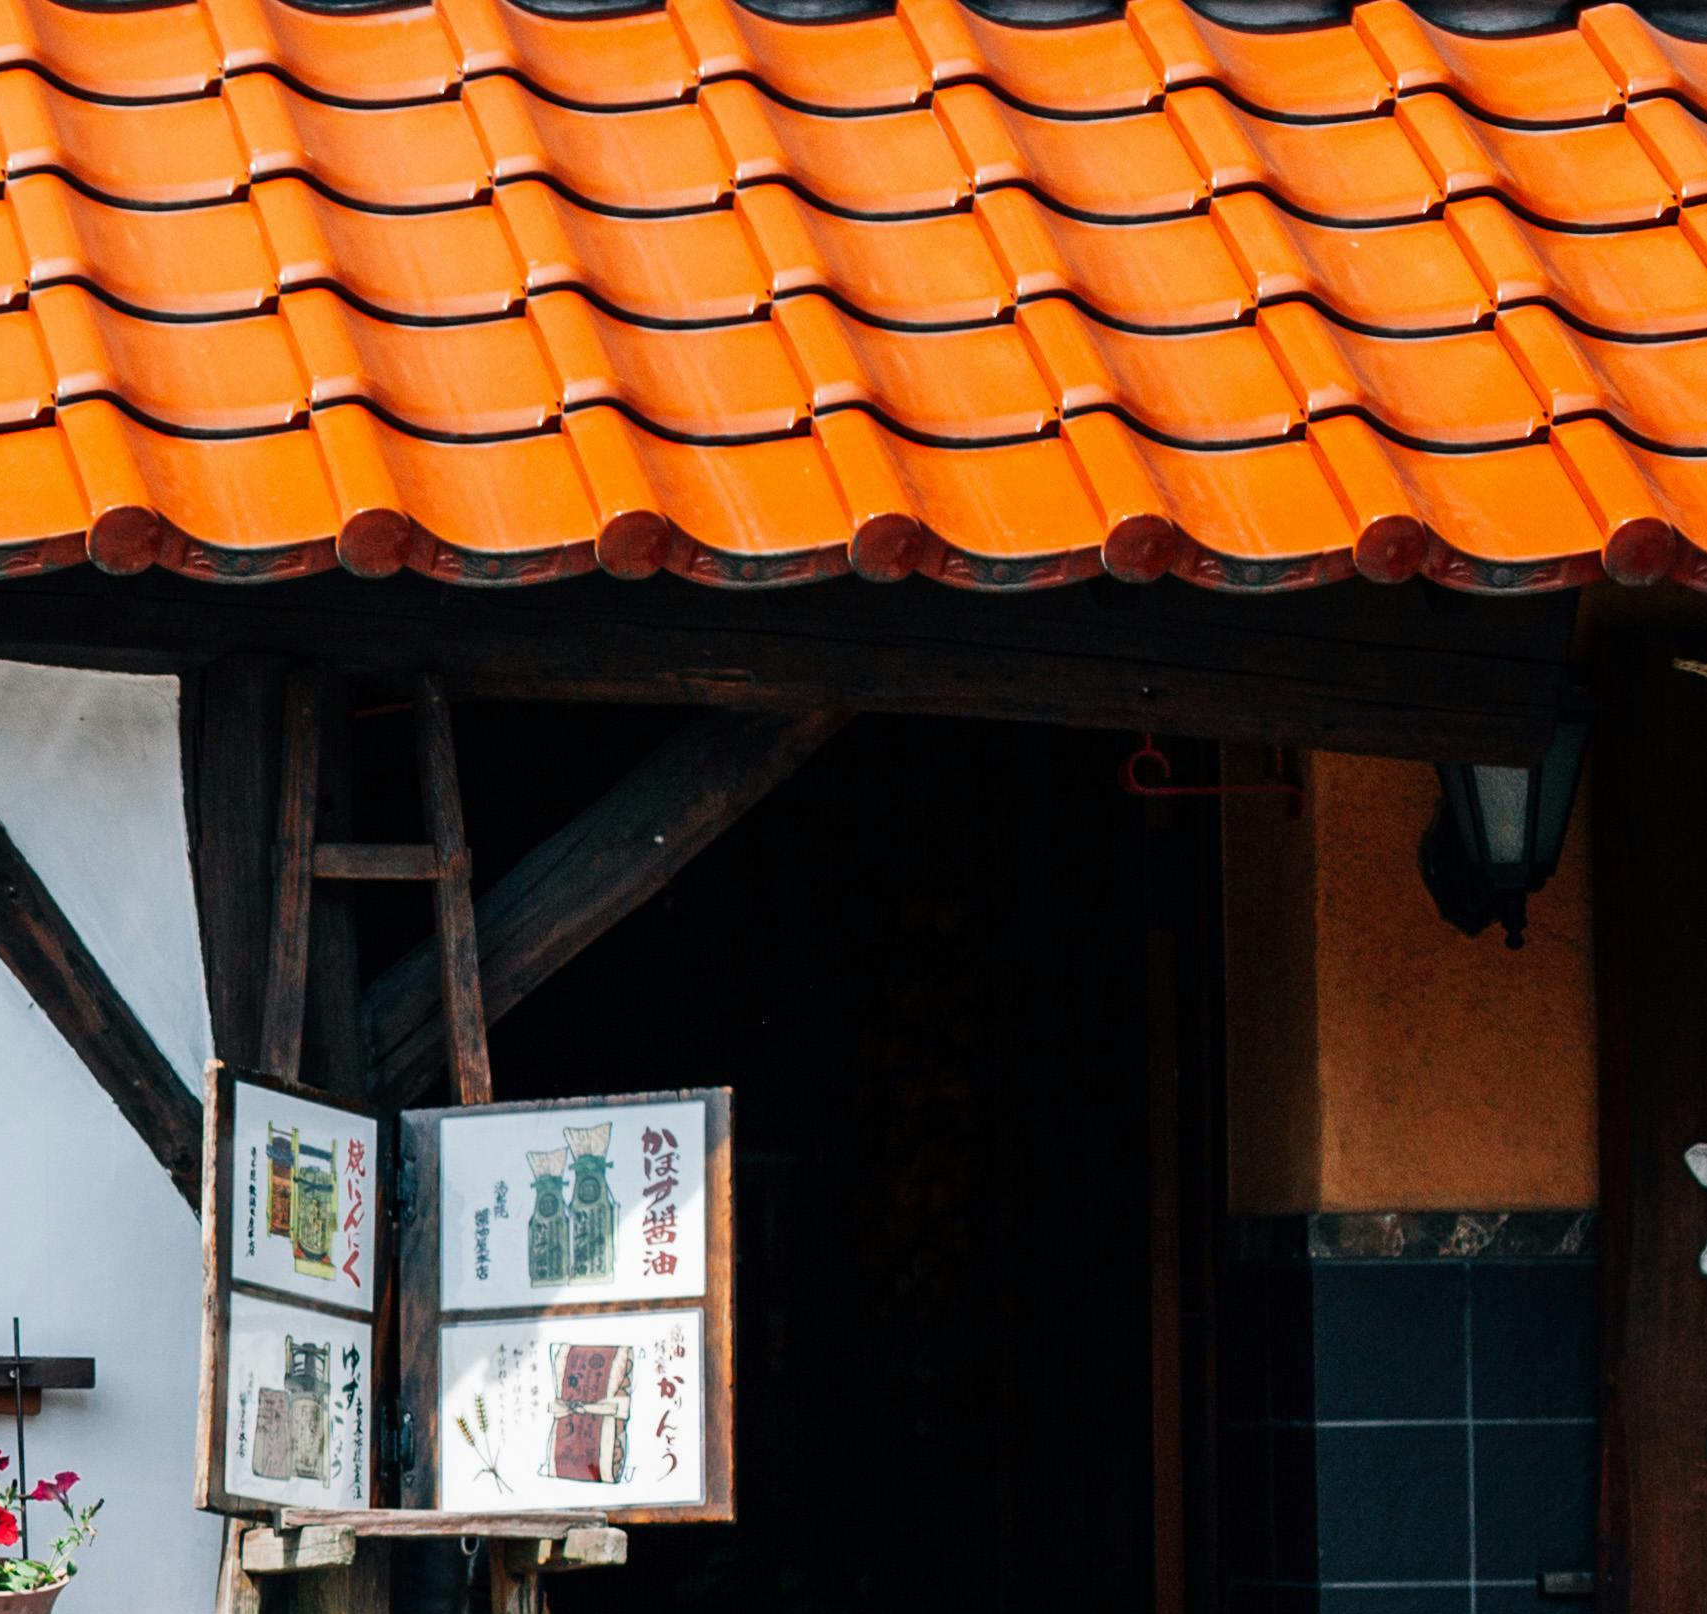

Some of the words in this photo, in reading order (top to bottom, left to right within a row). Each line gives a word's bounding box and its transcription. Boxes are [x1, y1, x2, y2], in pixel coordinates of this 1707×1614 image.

[642, 1125, 679, 1276] かぼす醤油
[655, 1375, 685, 1482] かりんとう
